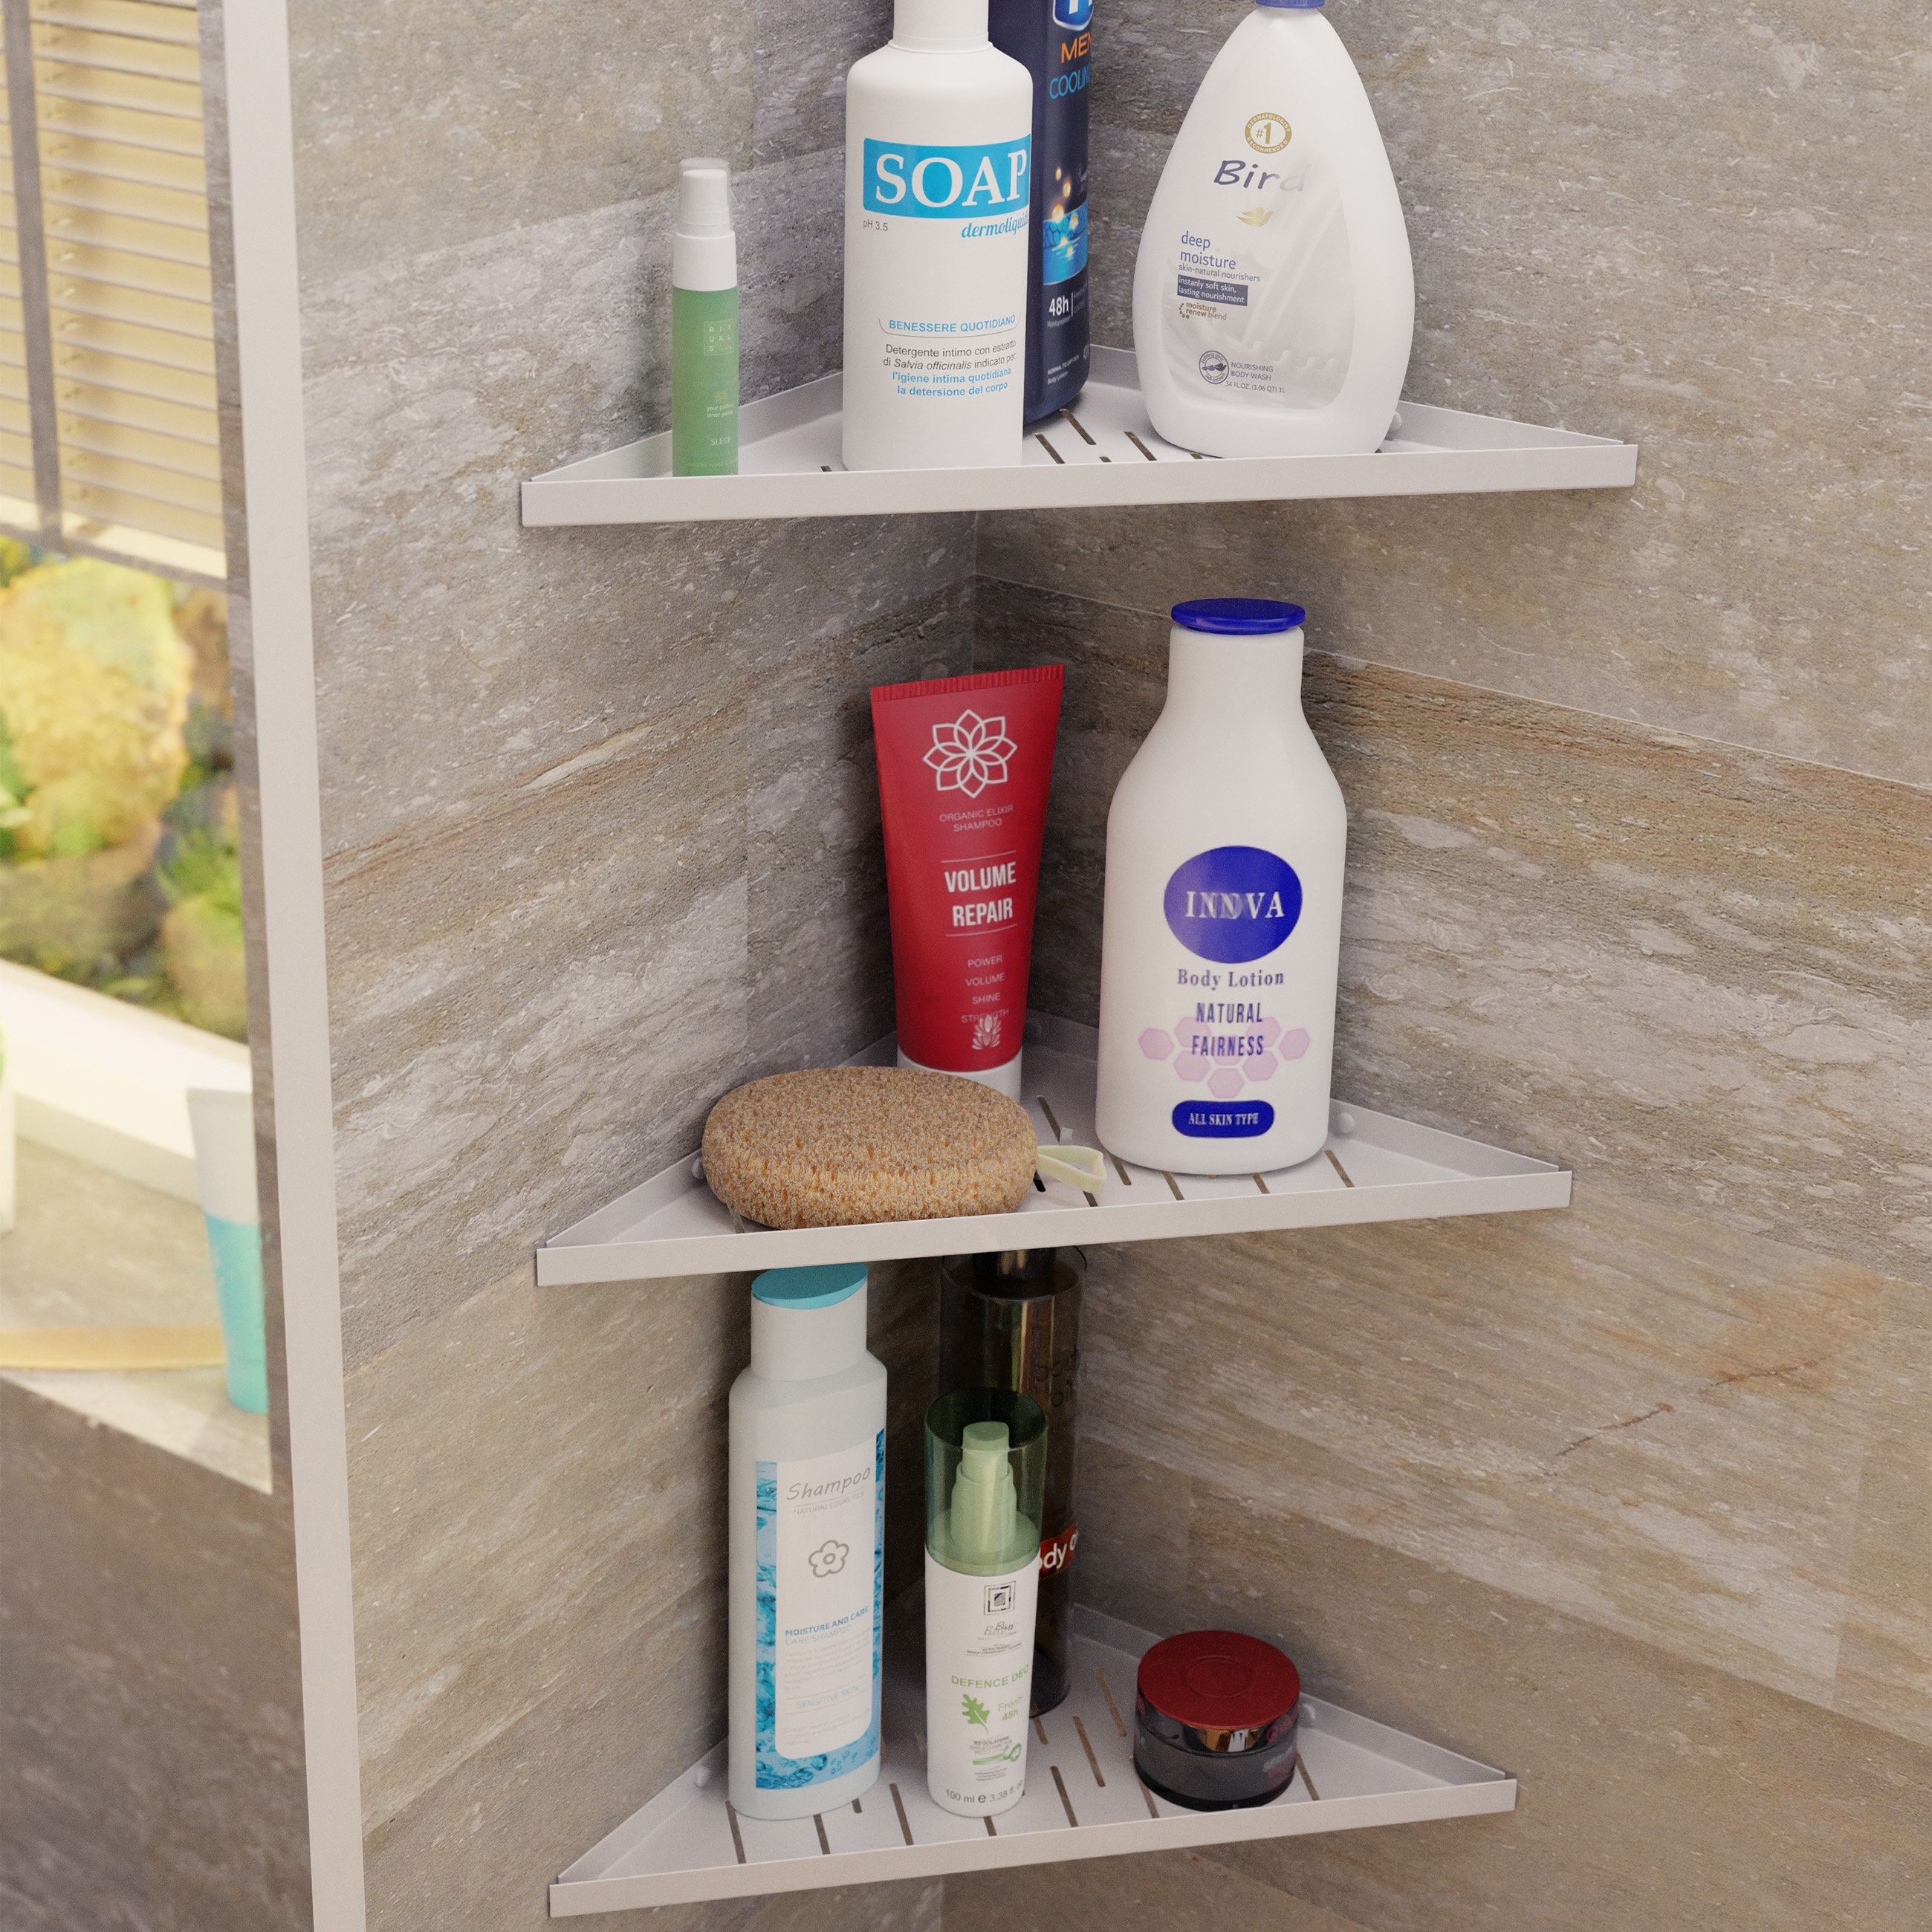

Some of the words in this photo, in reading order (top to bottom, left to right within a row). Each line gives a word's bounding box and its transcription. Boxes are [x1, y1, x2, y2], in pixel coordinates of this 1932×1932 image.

[1247, 113, 1291, 133] DERMATOLOGIST
[1255, 122, 1272, 145] #1
[1246, 136, 1288, 153] RECOMMENDED
[875, 149, 1028, 208] SOAP
[1213, 159, 1313, 192] Bird
[863, 220, 873, 230] pH
[875, 221, 889, 232] 3.5
[1181, 230, 1211, 251] deep
[1180, 250, 1236, 270] moisture
[1179, 263, 1220, 278] skin-natural
[1222, 270, 1261, 282] nourishers
[1179, 286, 1200, 298] lasting
[1201, 291, 1245, 304] nourishment
[1205, 282, 1219, 291] soft
[1220, 285, 1237, 294] skin,
[1048, 294, 1069, 317] 48h
[1186, 302, 1217, 313] moisture
[1185, 308, 1207, 318] renew
[1208, 311, 1228, 321] blend
[889, 320, 956, 332] BENESSERE
[960, 314, 1016, 333] QUOTIDIANO
[886, 343, 939, 358] Detergente
[942, 347, 972, 357] intimo
[974, 346, 991, 356] con
[992, 339, 1017, 354] estratto
[883, 357, 892, 367] di
[894, 359, 924, 370] Salvia
[927, 360, 973, 372] officinalis
[974, 357, 1005, 369] indicato
[1231, 361, 1274, 373] NOURISHING
[892, 371, 930, 384] l'igiene
[933, 373, 966, 383] intima
[967, 367, 1012, 384] quotidiana
[1231, 370, 1249, 378] BODY
[1250, 372, 1272, 381] WASH
[898, 385, 907, 395] la
[910, 387, 966, 397] detersione
[968, 385, 983, 395] del
[985, 380, 1008, 395] corpo
[711, 435, 732, 447] SLEEP
[939, 809, 985, 823] ORGANIC
[987, 804, 1014, 817] ELIXIR
[953, 817, 1003, 833] SHAMPOO
[944, 860, 1017, 893] VOLUME
[952, 897, 1014, 927] REPAIR
[967, 954, 1004, 968] POWER
[965, 972, 1005, 987] VOLUME
[1177, 968, 1221, 991] Body
[1228, 969, 1284, 988] Lotion
[972, 992, 1001, 1005] SHINE
[961, 1008, 1010, 1024] STRGTH
[1196, 1002, 1262, 1023] NATURAL
[1191, 1035, 1264, 1057] FAIRNESS
[1188, 1112, 1206, 1125] ALL
[1208, 1113, 1232, 1125] SKIN
[1234, 1112, 1259, 1125] TYPE
[786, 1467, 871, 1500] Shampoo
[794, 1503, 829, 1515] NATURAL
[785, 1622, 830, 1637] MOISTURE
[832, 1615, 849, 1629] AND
[850, 1605, 869, 1621] CARE
[951, 1675, 1009, 1689] DEFENCE
[946, 1789, 962, 1801] 100
[964, 1795, 975, 1803] ml
